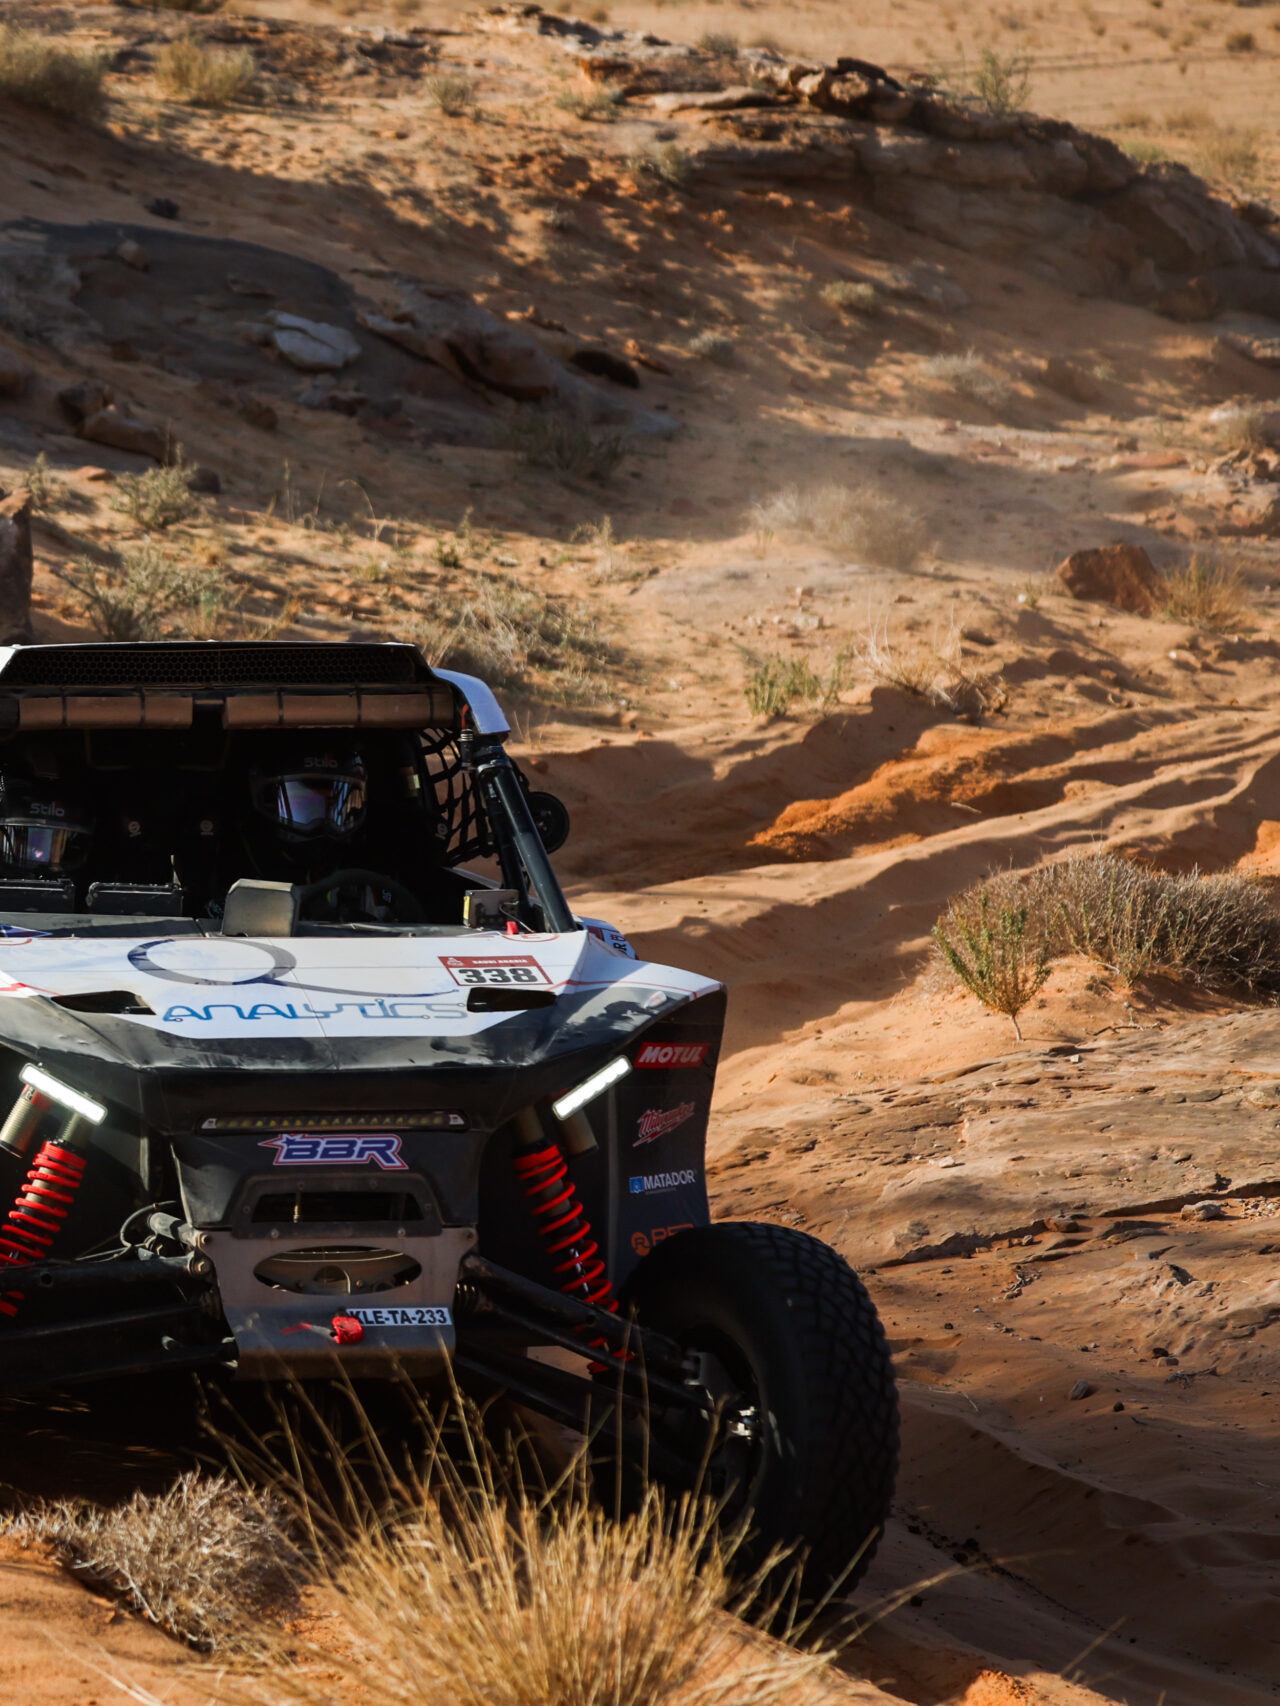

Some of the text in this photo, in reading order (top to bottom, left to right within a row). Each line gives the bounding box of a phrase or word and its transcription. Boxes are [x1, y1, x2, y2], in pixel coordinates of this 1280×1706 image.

[458, 967, 538, 983] 338
[638, 1046, 704, 1063] MOTUL
[280, 1135, 400, 1165] BBR
[643, 1169, 695, 1190] MATADOR
[349, 1309, 448, 1325] KLE-TA-233
